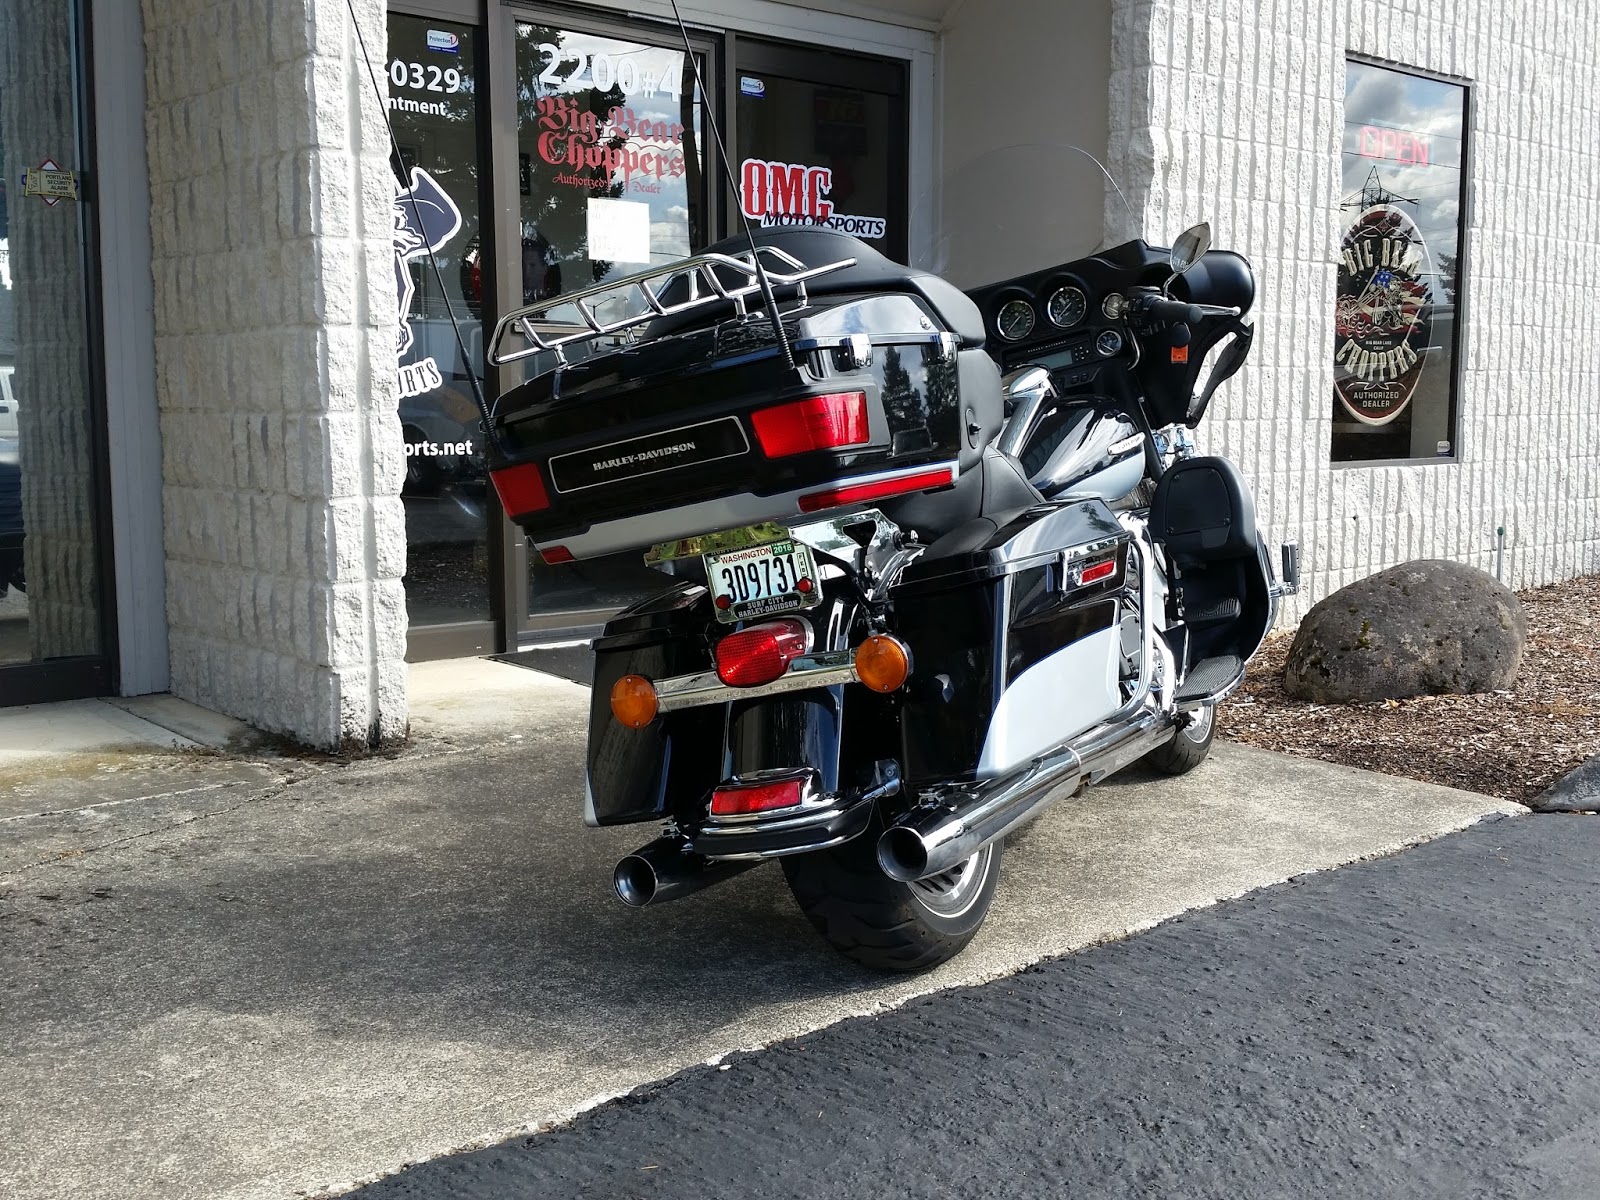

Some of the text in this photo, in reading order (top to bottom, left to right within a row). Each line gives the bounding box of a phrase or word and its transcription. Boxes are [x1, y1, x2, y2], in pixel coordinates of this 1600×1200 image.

[388, 96, 446, 116] ntment
[536, 96, 685, 146] Big Bear
[537, 130, 686, 190] Choppers
[1359, 125, 1430, 168] OPEN
[552, 172, 662, 194] Authorized Dealer
[743, 161, 832, 220] OMG
[763, 210, 884, 236] MOTORSPORTS
[1343, 239, 1374, 277] BIG
[1336, 338, 1418, 382] CHOPPERS
[1353, 390, 1399, 400] AUTHORIZED
[1362, 399, 1390, 408] DEALER
[592, 441, 696, 471] HARLEY-DAVIDSON
[720, 547, 772, 565] WASHINGTON
[773, 543, 792, 554] 2018
[721, 554, 799, 603] 3D9731
[738, 600, 798, 618] HARLEY-DAVIDSON
[747, 596, 785, 610] SURF CITY
